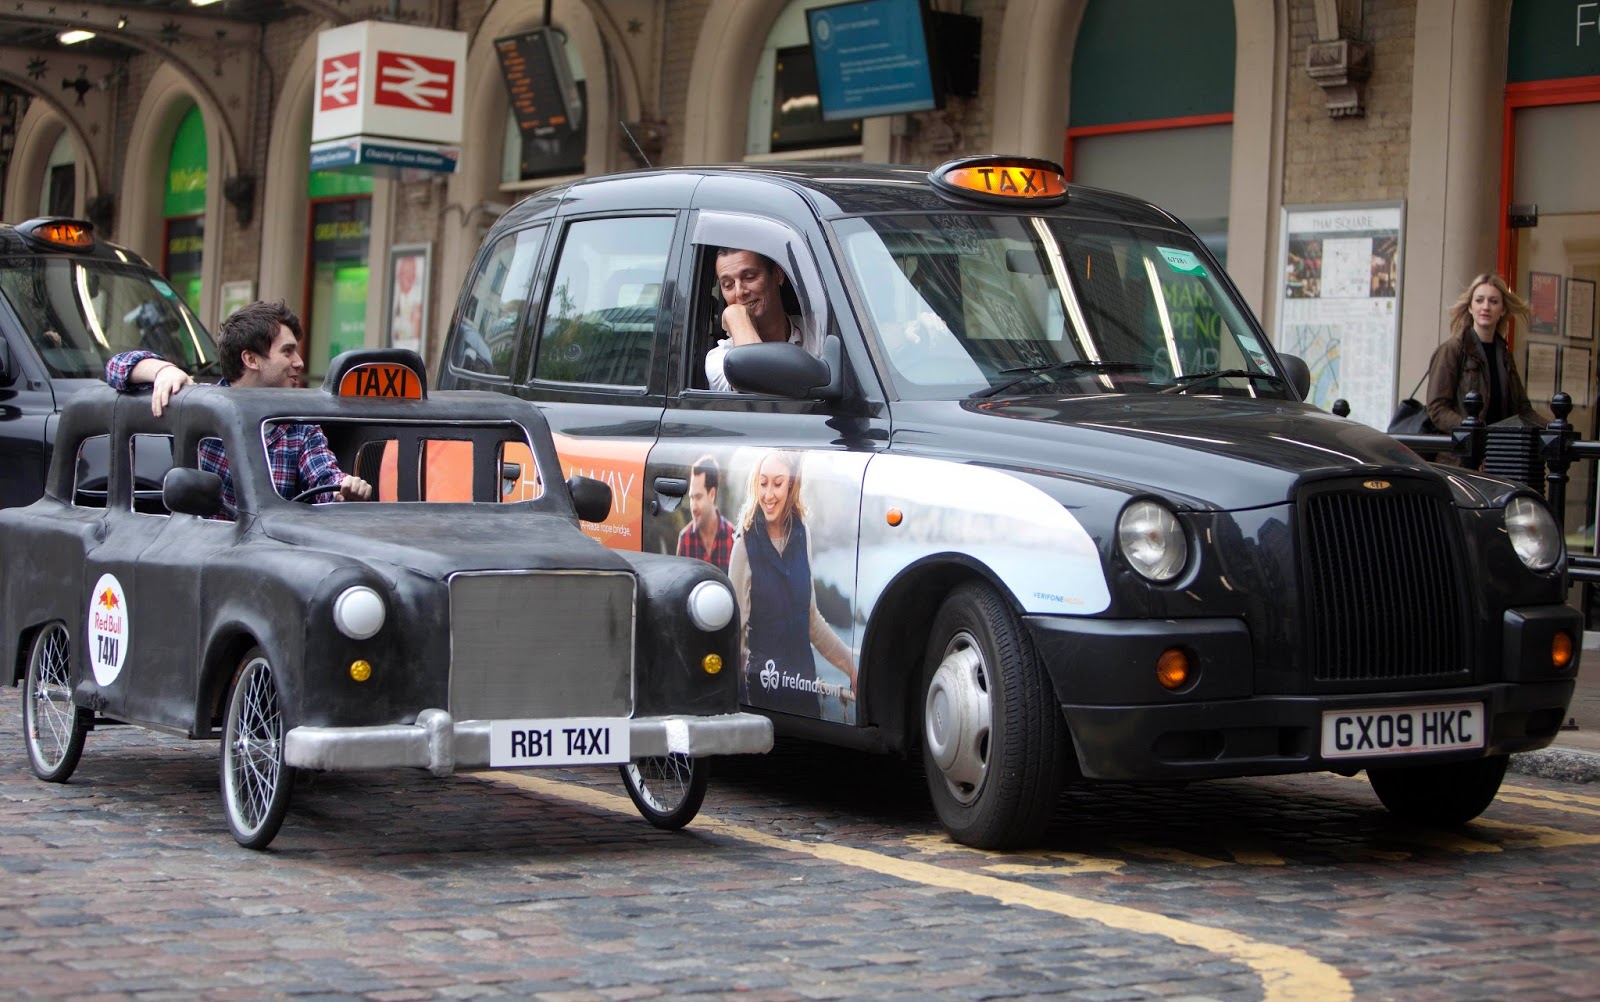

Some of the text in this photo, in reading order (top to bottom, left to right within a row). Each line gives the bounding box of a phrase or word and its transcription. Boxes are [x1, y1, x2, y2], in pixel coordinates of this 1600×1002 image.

[365, 148, 444, 165] Charing Cross Station
[976, 168, 1049, 194] TAXI
[1334, 215, 1374, 229] SQUARE
[353, 367, 408, 398] TAXI
[1033, 591, 1064, 603] VERIFONE
[95, 612, 122, 635] Red Bull
[97, 634, 119, 668] T4XI
[782, 670, 841, 697] ireland.com
[511, 727, 610, 758] RB1 T4XI
[1335, 709, 1473, 751] GX09 HKC
